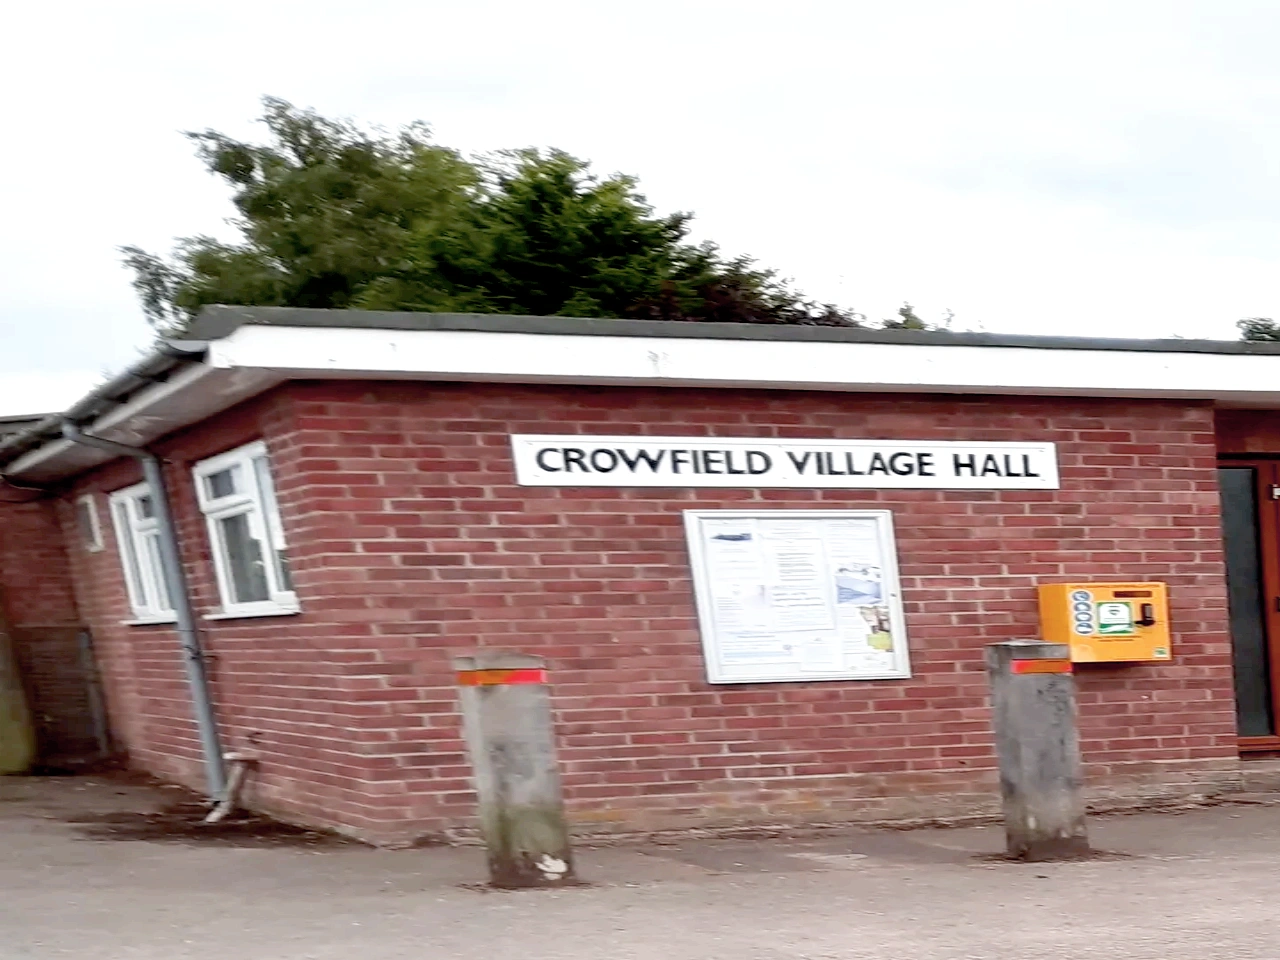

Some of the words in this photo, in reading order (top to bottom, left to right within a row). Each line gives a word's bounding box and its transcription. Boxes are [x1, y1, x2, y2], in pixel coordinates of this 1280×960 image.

[536, 447, 772, 475] CROWFIELD
[786, 451, 936, 477] VILLAGE
[953, 453, 1040, 478] HALL
